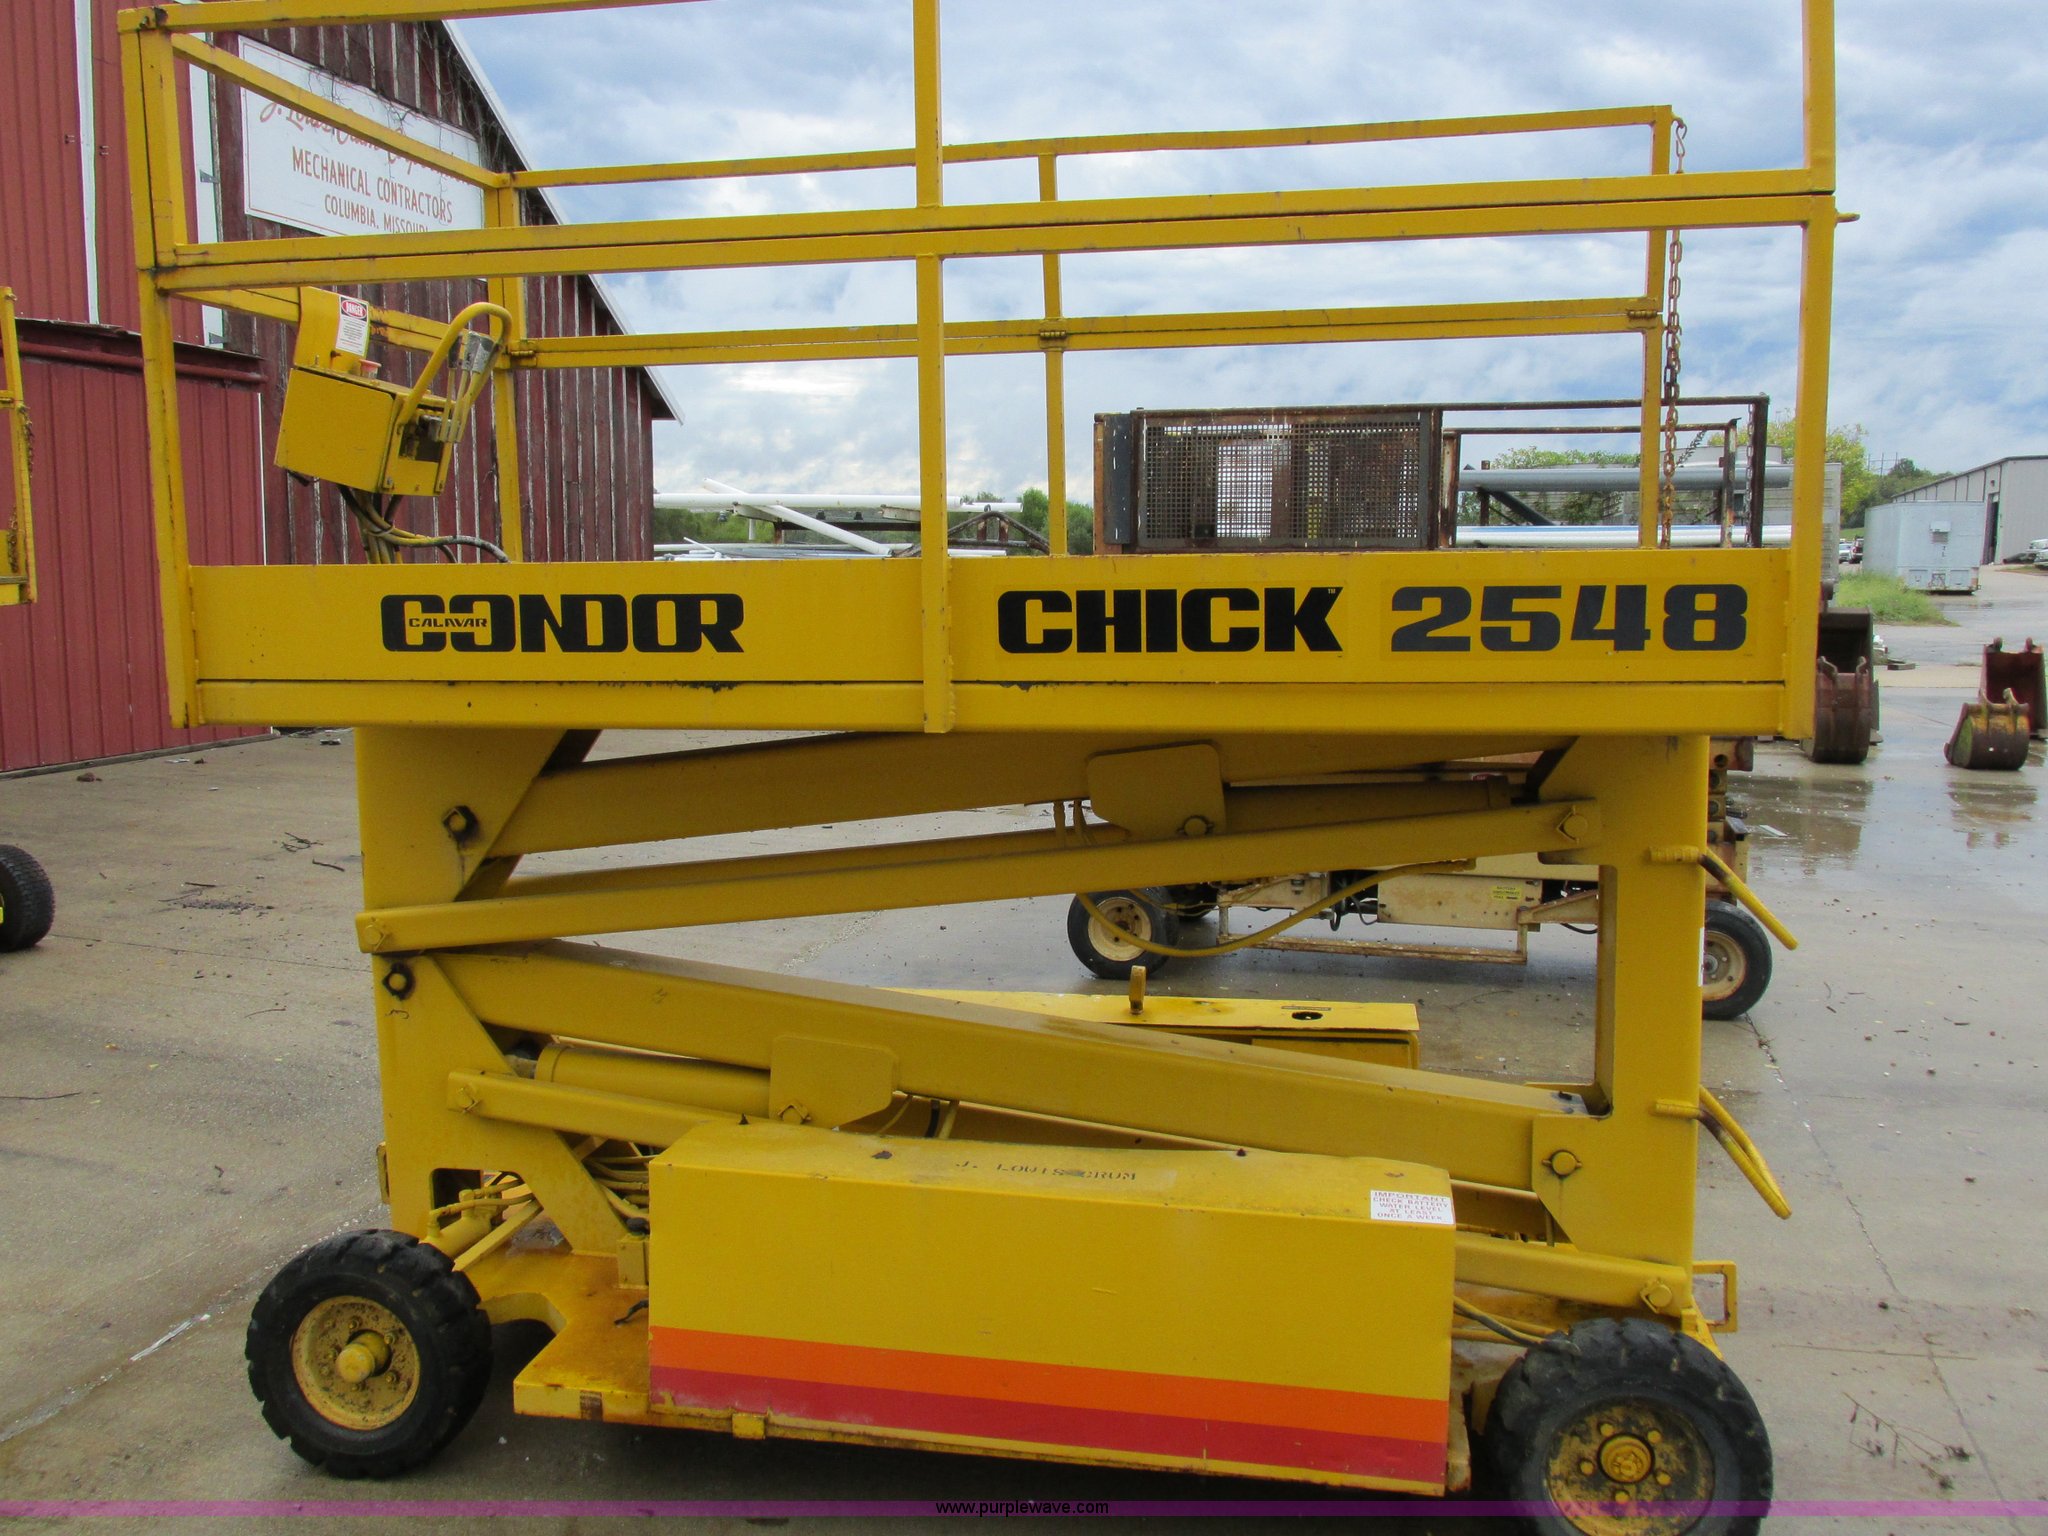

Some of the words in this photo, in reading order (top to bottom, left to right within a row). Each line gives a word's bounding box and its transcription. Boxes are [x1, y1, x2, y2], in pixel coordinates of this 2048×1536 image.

[292, 146, 371, 197] MECHANICAL
[377, 177, 453, 223] CONTRACTORS
[384, 212, 428, 233] MISSOU
[381, 594, 745, 652] CONDOR
[409, 618, 487, 627] CALAVAR
[998, 587, 1344, 653] CHICK
[1391, 584, 1748, 652] 2548
[1374, 1191, 1447, 1202] IMPORTANT
[1408, 1199, 1448, 1208] BATTERY
